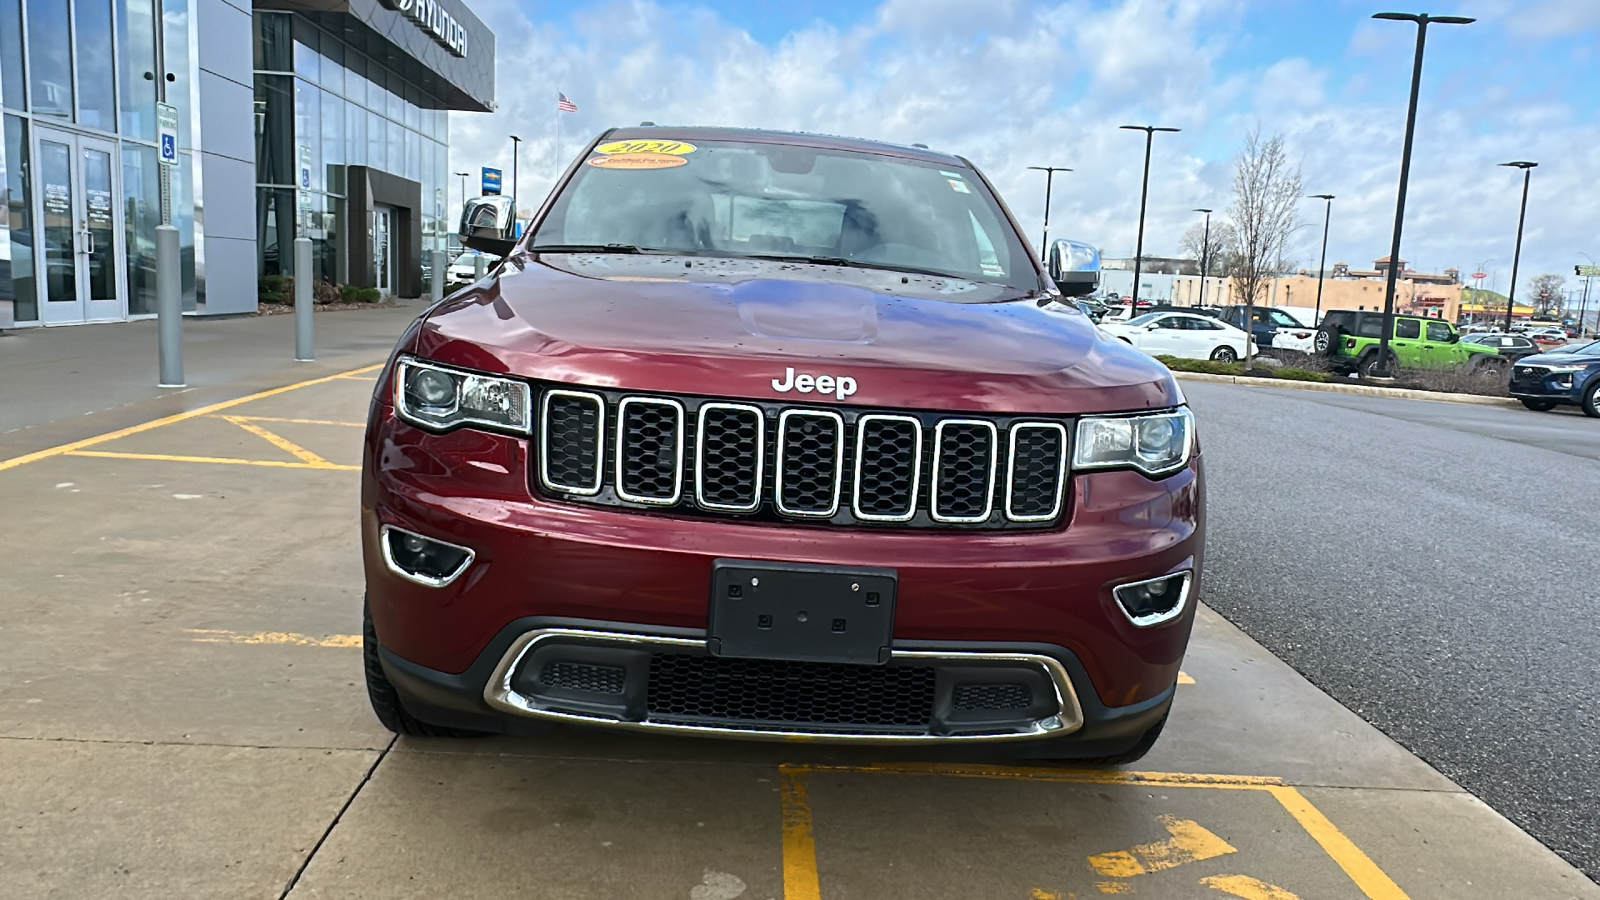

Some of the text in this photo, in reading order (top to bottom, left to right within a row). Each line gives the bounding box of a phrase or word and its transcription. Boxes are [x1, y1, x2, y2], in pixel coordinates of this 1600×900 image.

[415, 0, 468, 58] HYUNDAI
[608, 142, 682, 153] 2020
[771, 366, 858, 401] Jeep
